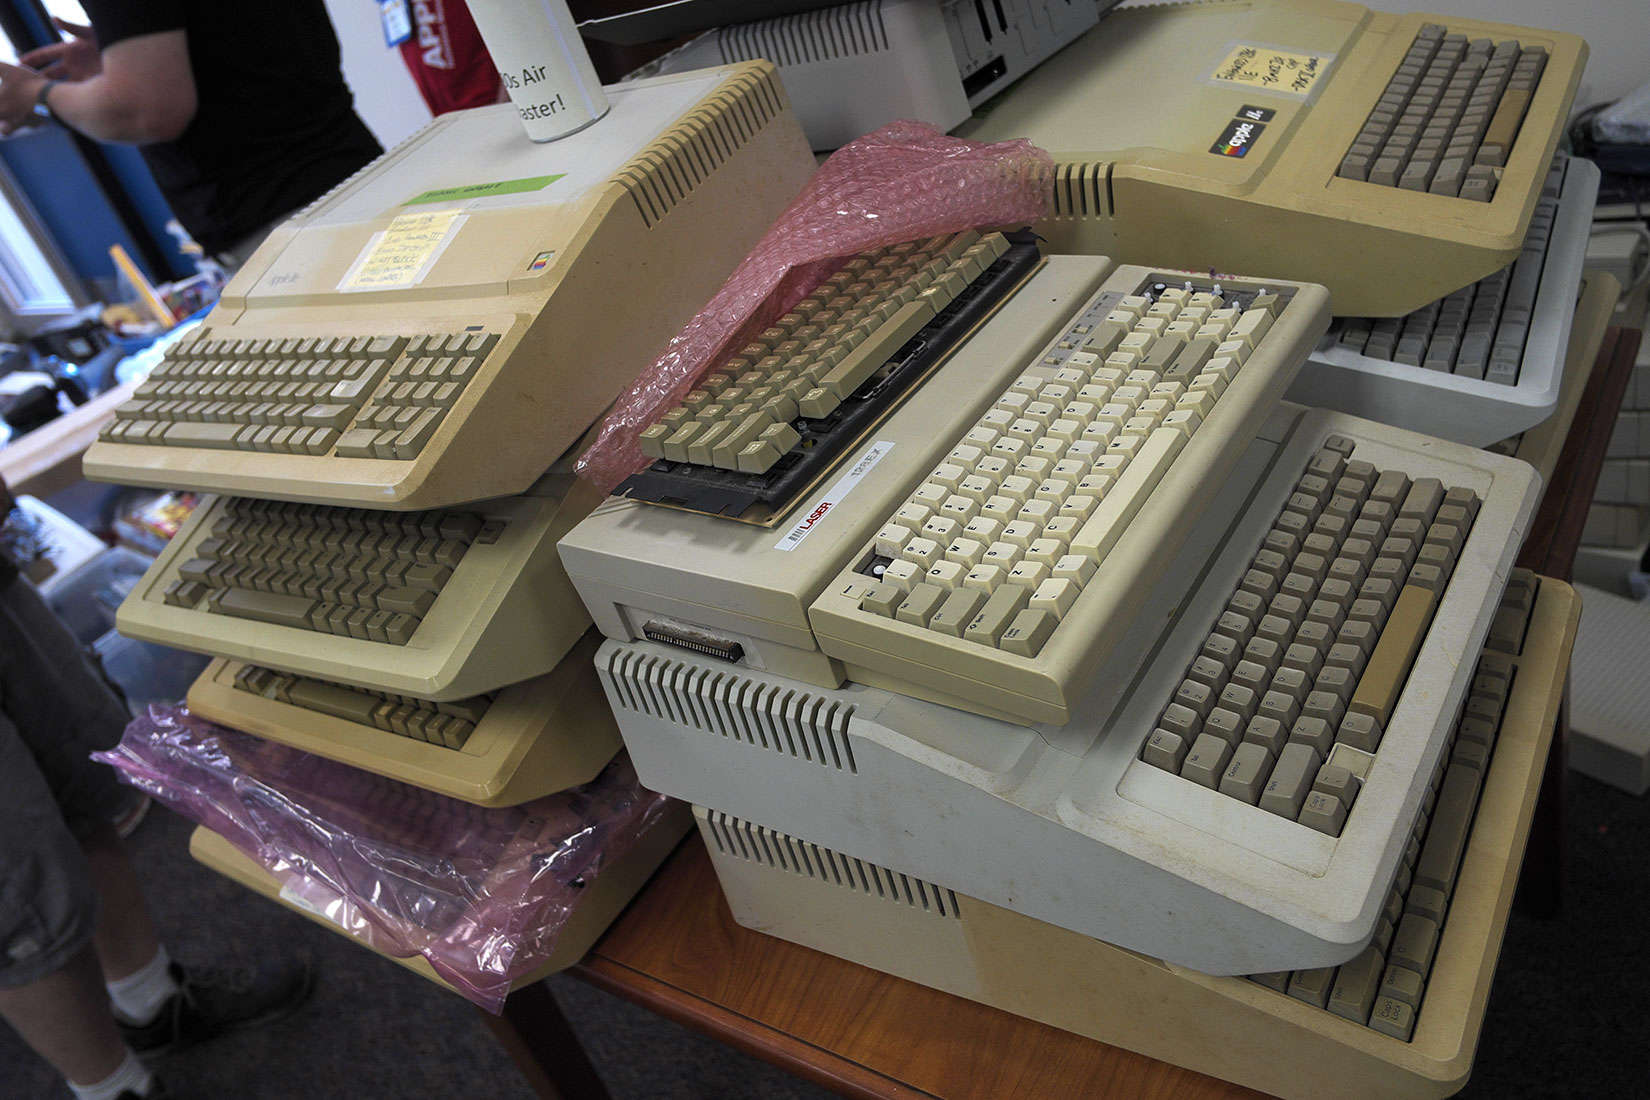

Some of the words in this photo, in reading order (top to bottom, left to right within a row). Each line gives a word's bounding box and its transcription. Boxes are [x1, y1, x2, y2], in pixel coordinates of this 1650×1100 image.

[522, 65, 547, 86] Air
[1229, 123, 1254, 147] apple
[800, 502, 833, 531] LASER
